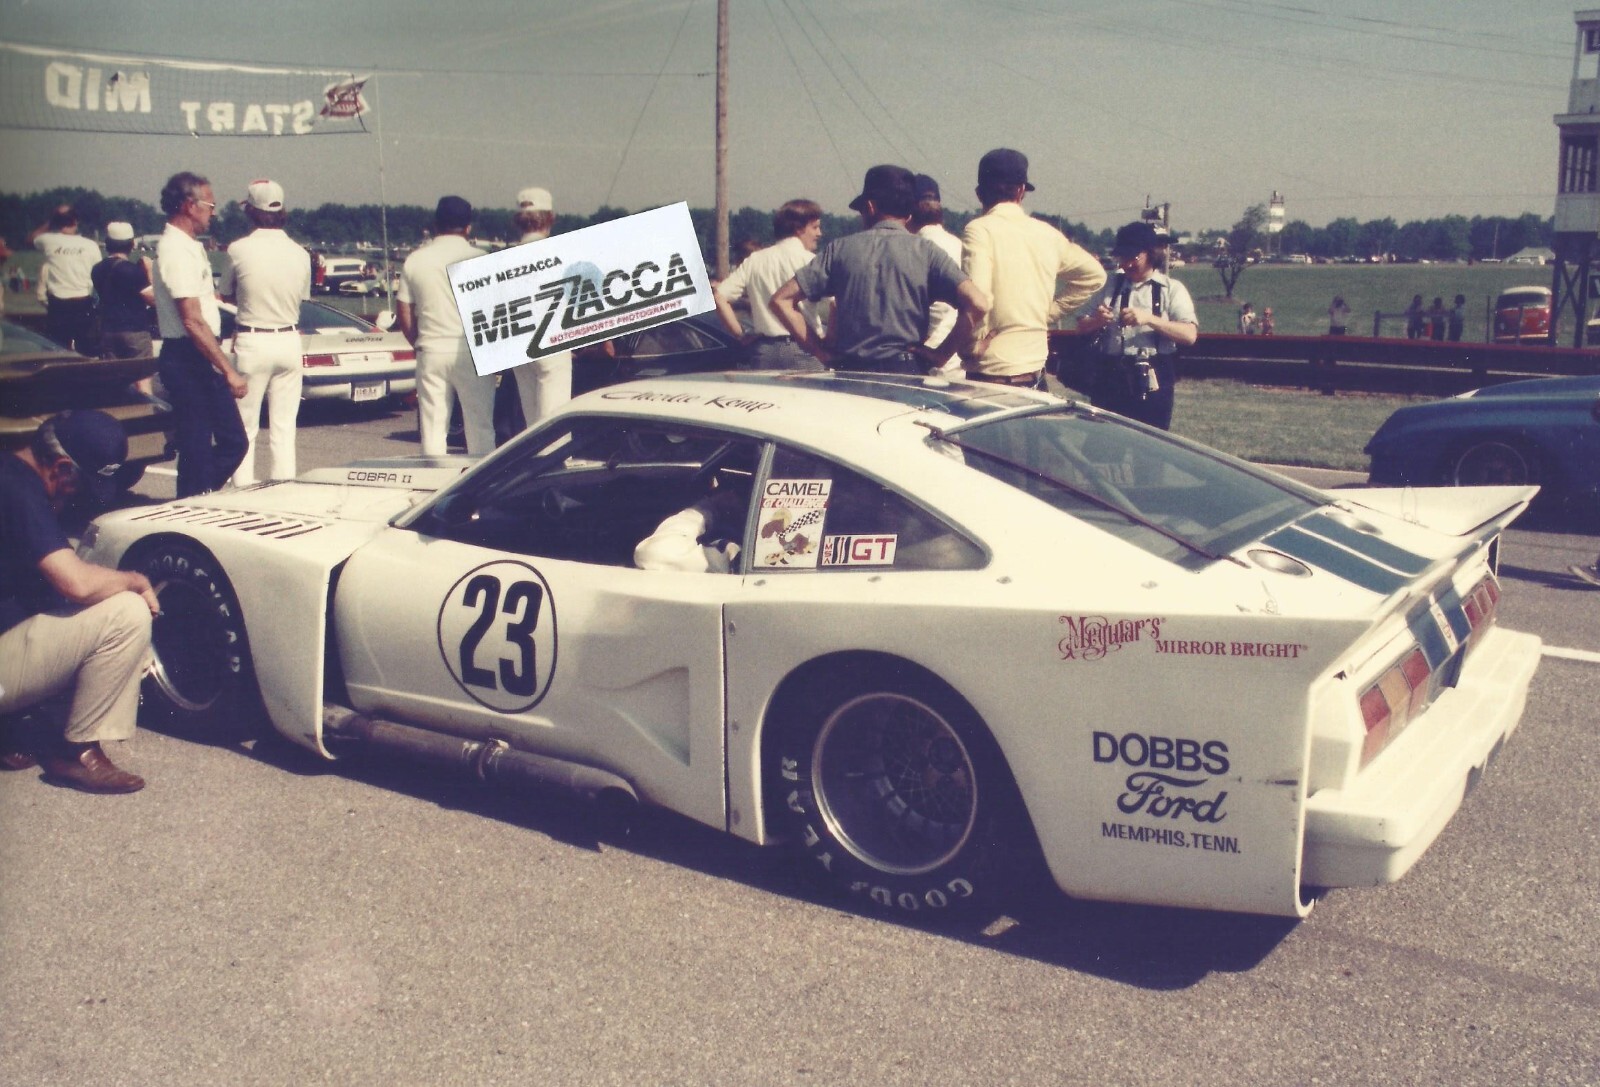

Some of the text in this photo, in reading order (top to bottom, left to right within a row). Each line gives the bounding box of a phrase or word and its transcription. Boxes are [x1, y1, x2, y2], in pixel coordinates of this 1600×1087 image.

[704, 395, 775, 413] Kemp
[347, 470, 412, 484] COBRA II
[766, 482, 828, 496] CAMEL
[822, 537, 834, 564] IMSA
[851, 537, 895, 561] GT
[459, 574, 544, 697] 23
[1155, 639, 1302, 659] MIRROR BRIGHT
[1093, 731, 1230, 775] DOBBS
[1117, 771, 1228, 823] Ford
